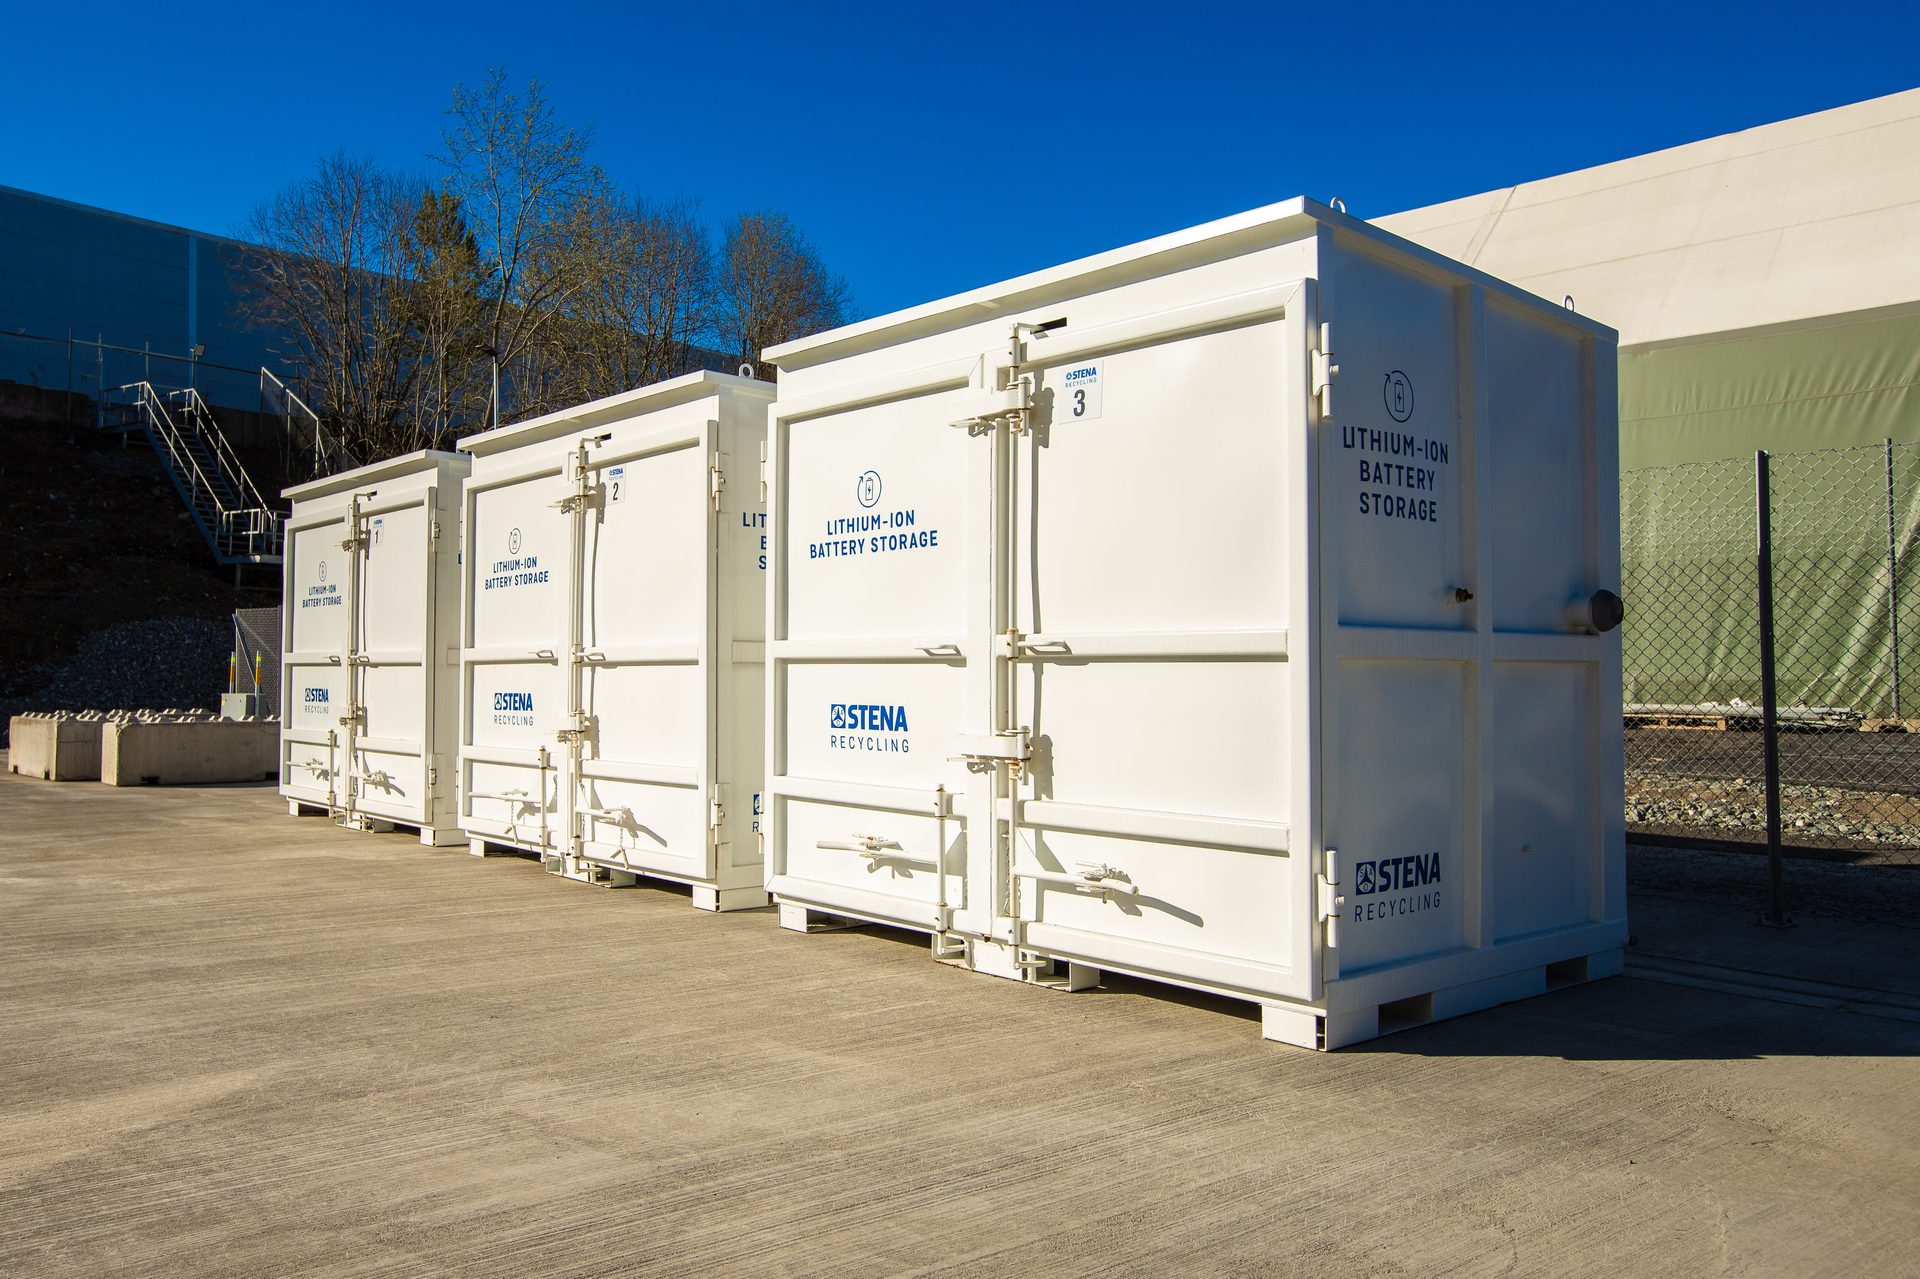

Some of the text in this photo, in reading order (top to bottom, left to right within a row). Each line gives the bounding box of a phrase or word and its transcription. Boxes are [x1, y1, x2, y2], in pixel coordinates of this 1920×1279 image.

[1065, 377, 1097, 388] RECYCLING
[1072, 367, 1097, 380] STENA
[1073, 389, 1086, 417] 3
[1343, 426, 1448, 465] LITHIUM-ION
[1360, 460, 1435, 491] BATTERY
[612, 482, 619, 501] 2
[1360, 492, 1437, 522] STORAGE
[827, 510, 915, 536] LITHIUM-ION
[810, 530, 938, 559] BATTERY STORAGE
[493, 556, 537, 573] LITHIUM-ION
[485, 571, 549, 590] BATTERY STORAGE
[302, 595, 342, 608] BATTERY STORAGE
[311, 688, 329, 702] STENA
[503, 692, 534, 711] STENA
[493, 714, 534, 726] RECYCLING
[847, 704, 909, 732] STENA
[831, 735, 909, 753] RECYCLING
[1378, 852, 1441, 893] STENA
[1355, 891, 1441, 923] RECYCLING
